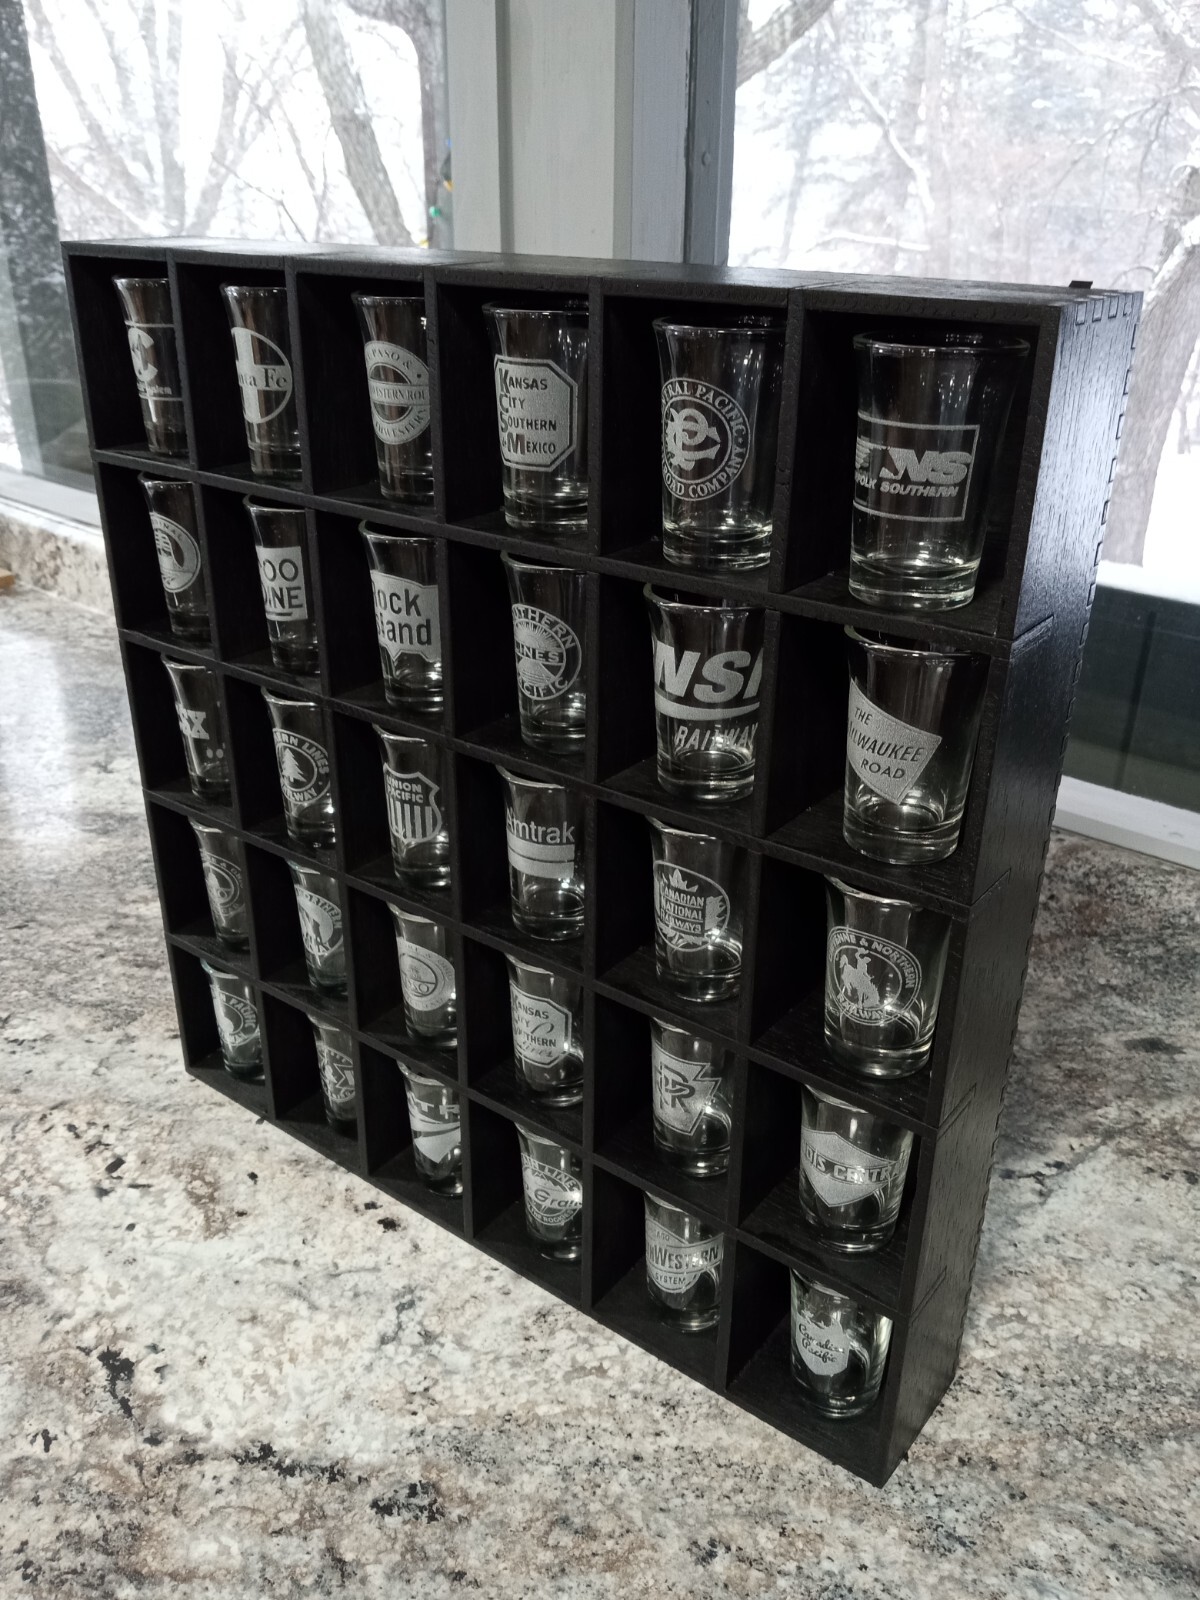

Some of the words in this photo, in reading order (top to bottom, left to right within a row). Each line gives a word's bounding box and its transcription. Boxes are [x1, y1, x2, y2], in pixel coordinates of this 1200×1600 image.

[264, 367, 288, 389] Fe
[499, 367, 548, 396] KANSAS
[499, 393, 526, 414] CITY
[695, 385, 747, 436] PACIFIC
[500, 411, 558, 433] SOUTHERN
[507, 432, 557, 456] MEXICO
[688, 446, 747, 499] COMPANY
[879, 446, 973, 486] NS
[879, 481, 960, 498] SOUTHERN
[260, 558, 299, 583] OO
[262, 586, 304, 609] INE
[373, 580, 422, 617] ock
[376, 612, 432, 646] land
[516, 641, 560, 663] INES
[854, 706, 873, 726] THE
[860, 758, 906, 780] ROAD
[386, 774, 423, 794] UNION
[387, 784, 424, 804] PACIFIC
[506, 806, 576, 844] Amtrak
[660, 894, 703, 920] NATIONAL
[660, 907, 702, 934] RAILWAYS
[871, 941, 916, 990] NORTHERN
[655, 1243, 720, 1270] WESTRN
[655, 1271, 686, 1285] SYSTEM
